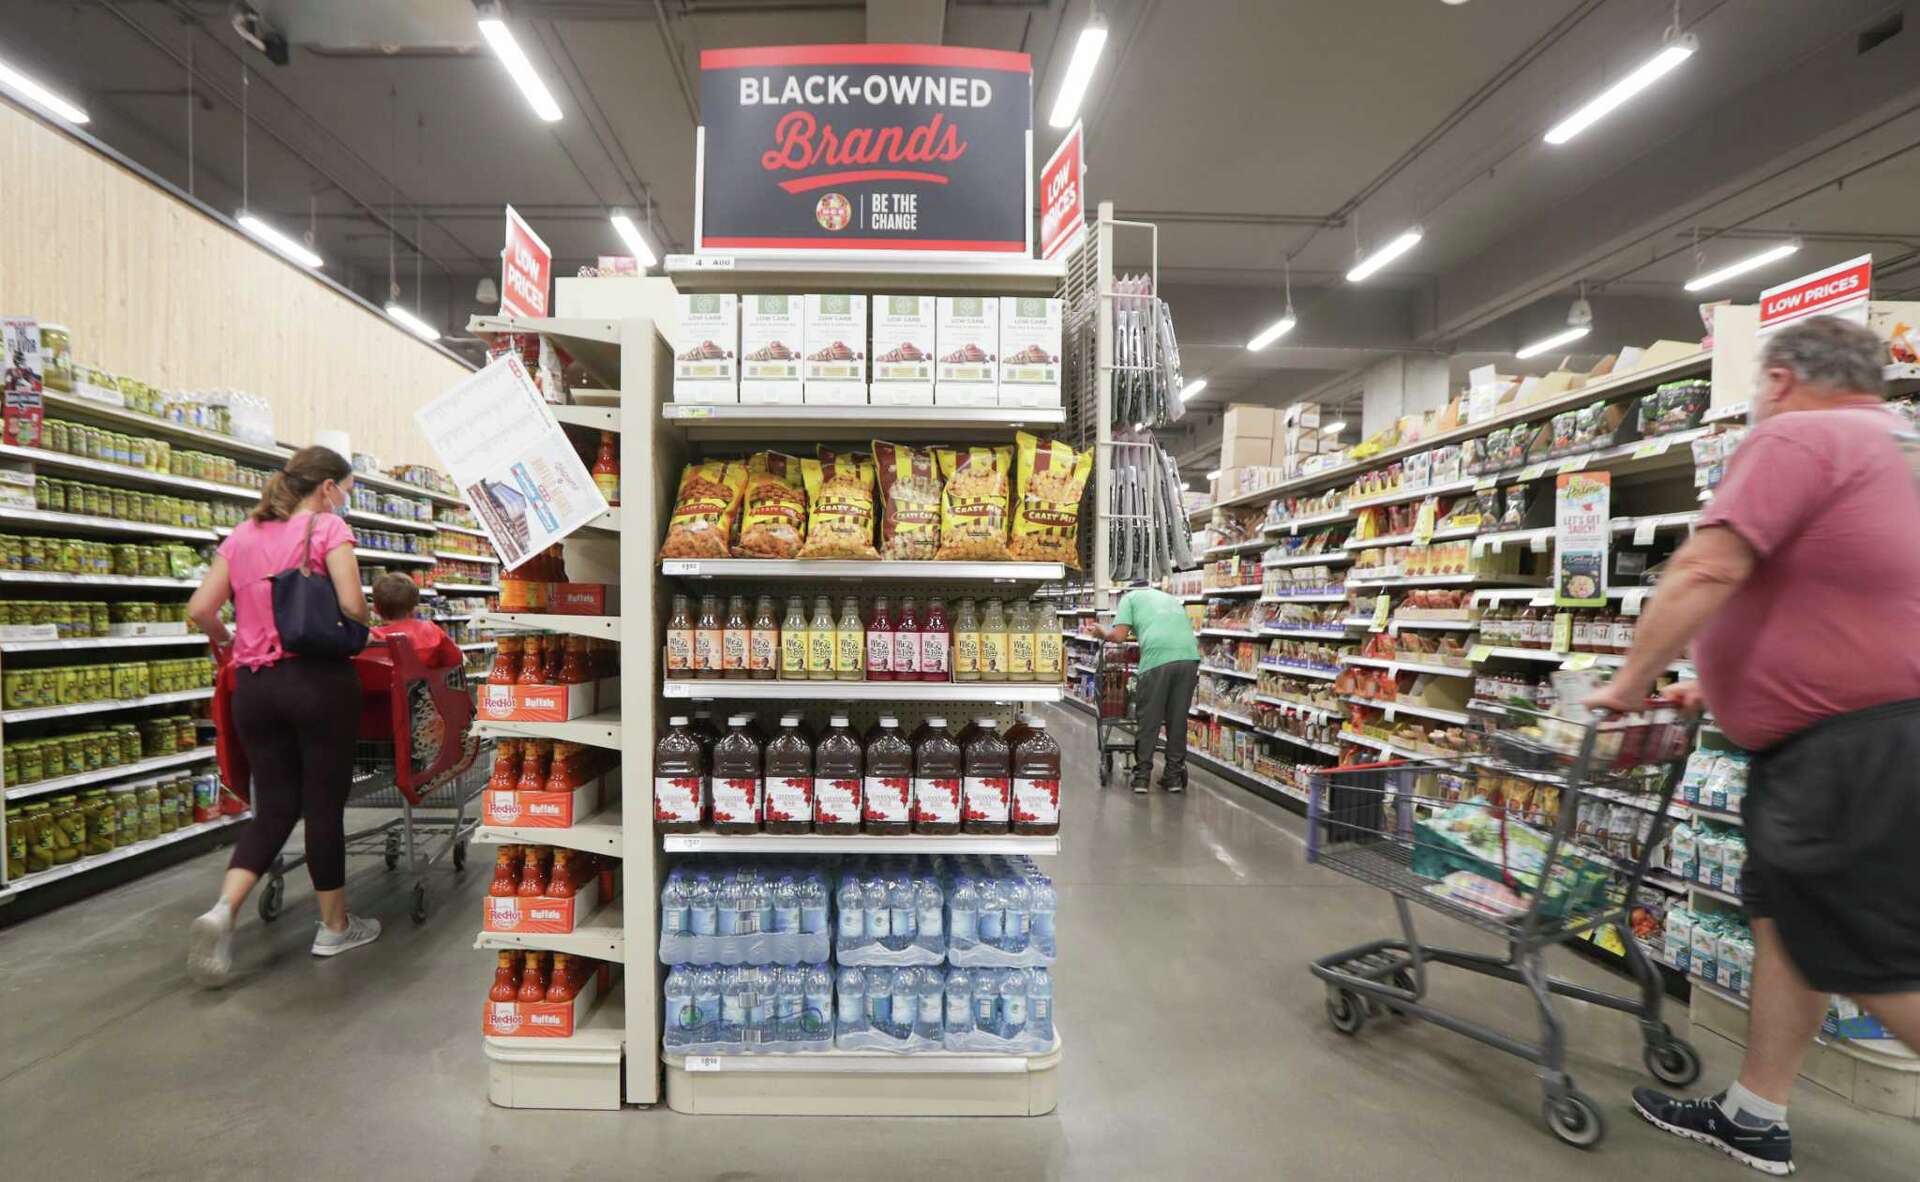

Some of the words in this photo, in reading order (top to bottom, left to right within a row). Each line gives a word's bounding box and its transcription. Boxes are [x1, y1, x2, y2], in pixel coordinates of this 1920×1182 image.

[739, 74, 992, 107] BLACK-OWNED
[761, 111, 967, 170] Brands
[1048, 159, 1070, 206] LOW
[871, 193, 888, 213] BE
[891, 193, 917, 213] THE
[871, 213, 917, 230] CHANGE
[514, 240, 541, 285] LOW
[508, 263, 545, 312] PRICES
[1768, 294, 1802, 314] LOW
[1805, 275, 1858, 303] PRICES
[820, 504, 849, 512] CRAZY
[955, 505, 984, 513] CRAZY
[1029, 511, 1058, 521] CRAZY
[484, 697, 516, 708] RedHot
[490, 803, 521, 814] RedHot
[491, 910, 522, 920] RedHot
[491, 1014, 522, 1025] RedHot
